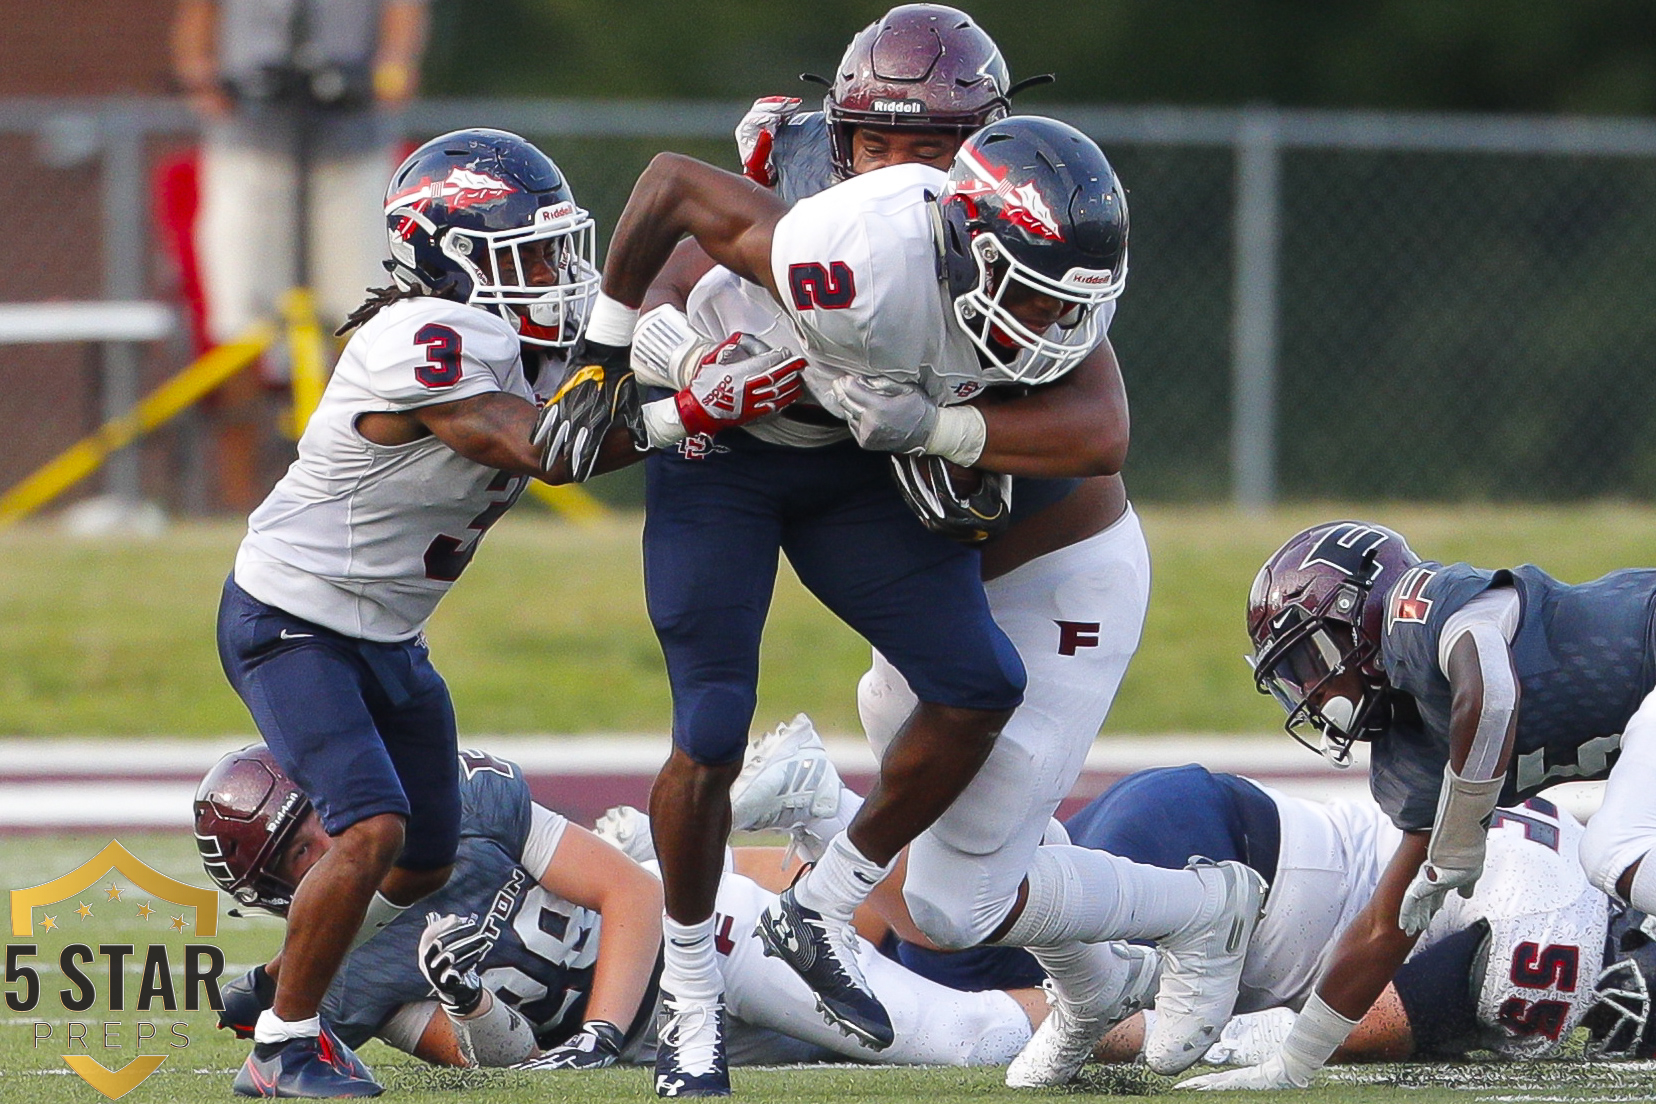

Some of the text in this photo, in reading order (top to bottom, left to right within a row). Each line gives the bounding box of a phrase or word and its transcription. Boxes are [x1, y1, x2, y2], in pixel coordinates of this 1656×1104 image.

[542, 204, 573, 221] Riddell
[789, 260, 856, 310] 2
[413, 322, 463, 389] 3
[702, 375, 733, 407] adidas
[1387, 567, 1437, 636] F
[1050, 618, 1102, 657] F
